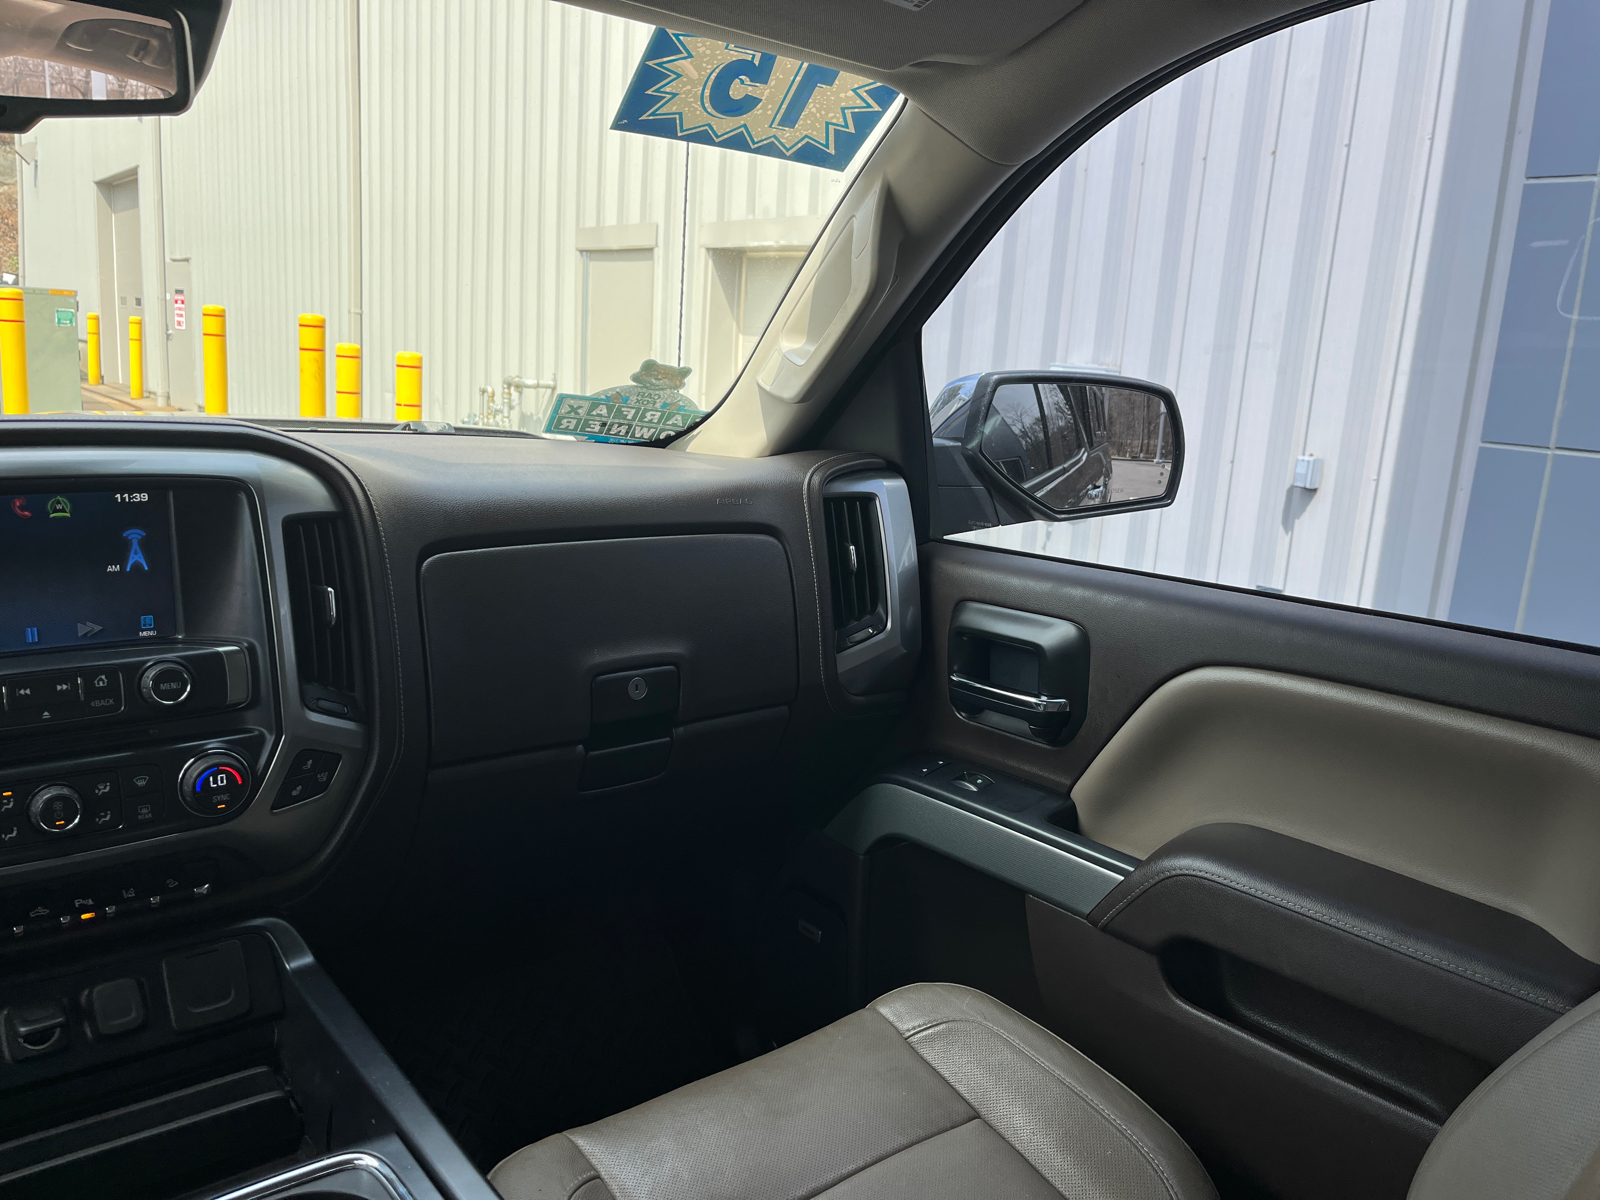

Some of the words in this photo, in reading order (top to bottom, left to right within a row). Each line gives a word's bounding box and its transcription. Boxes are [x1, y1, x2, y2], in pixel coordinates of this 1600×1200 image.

[115, 493, 148, 502] 11:39
[106, 564, 120, 572] AM
[160, 681, 182, 690] MENU
[95, 698, 115, 707] BACK
[209, 774, 227, 788] LO
[212, 793, 231, 803] SYNC
[138, 812, 152, 820] REAR
